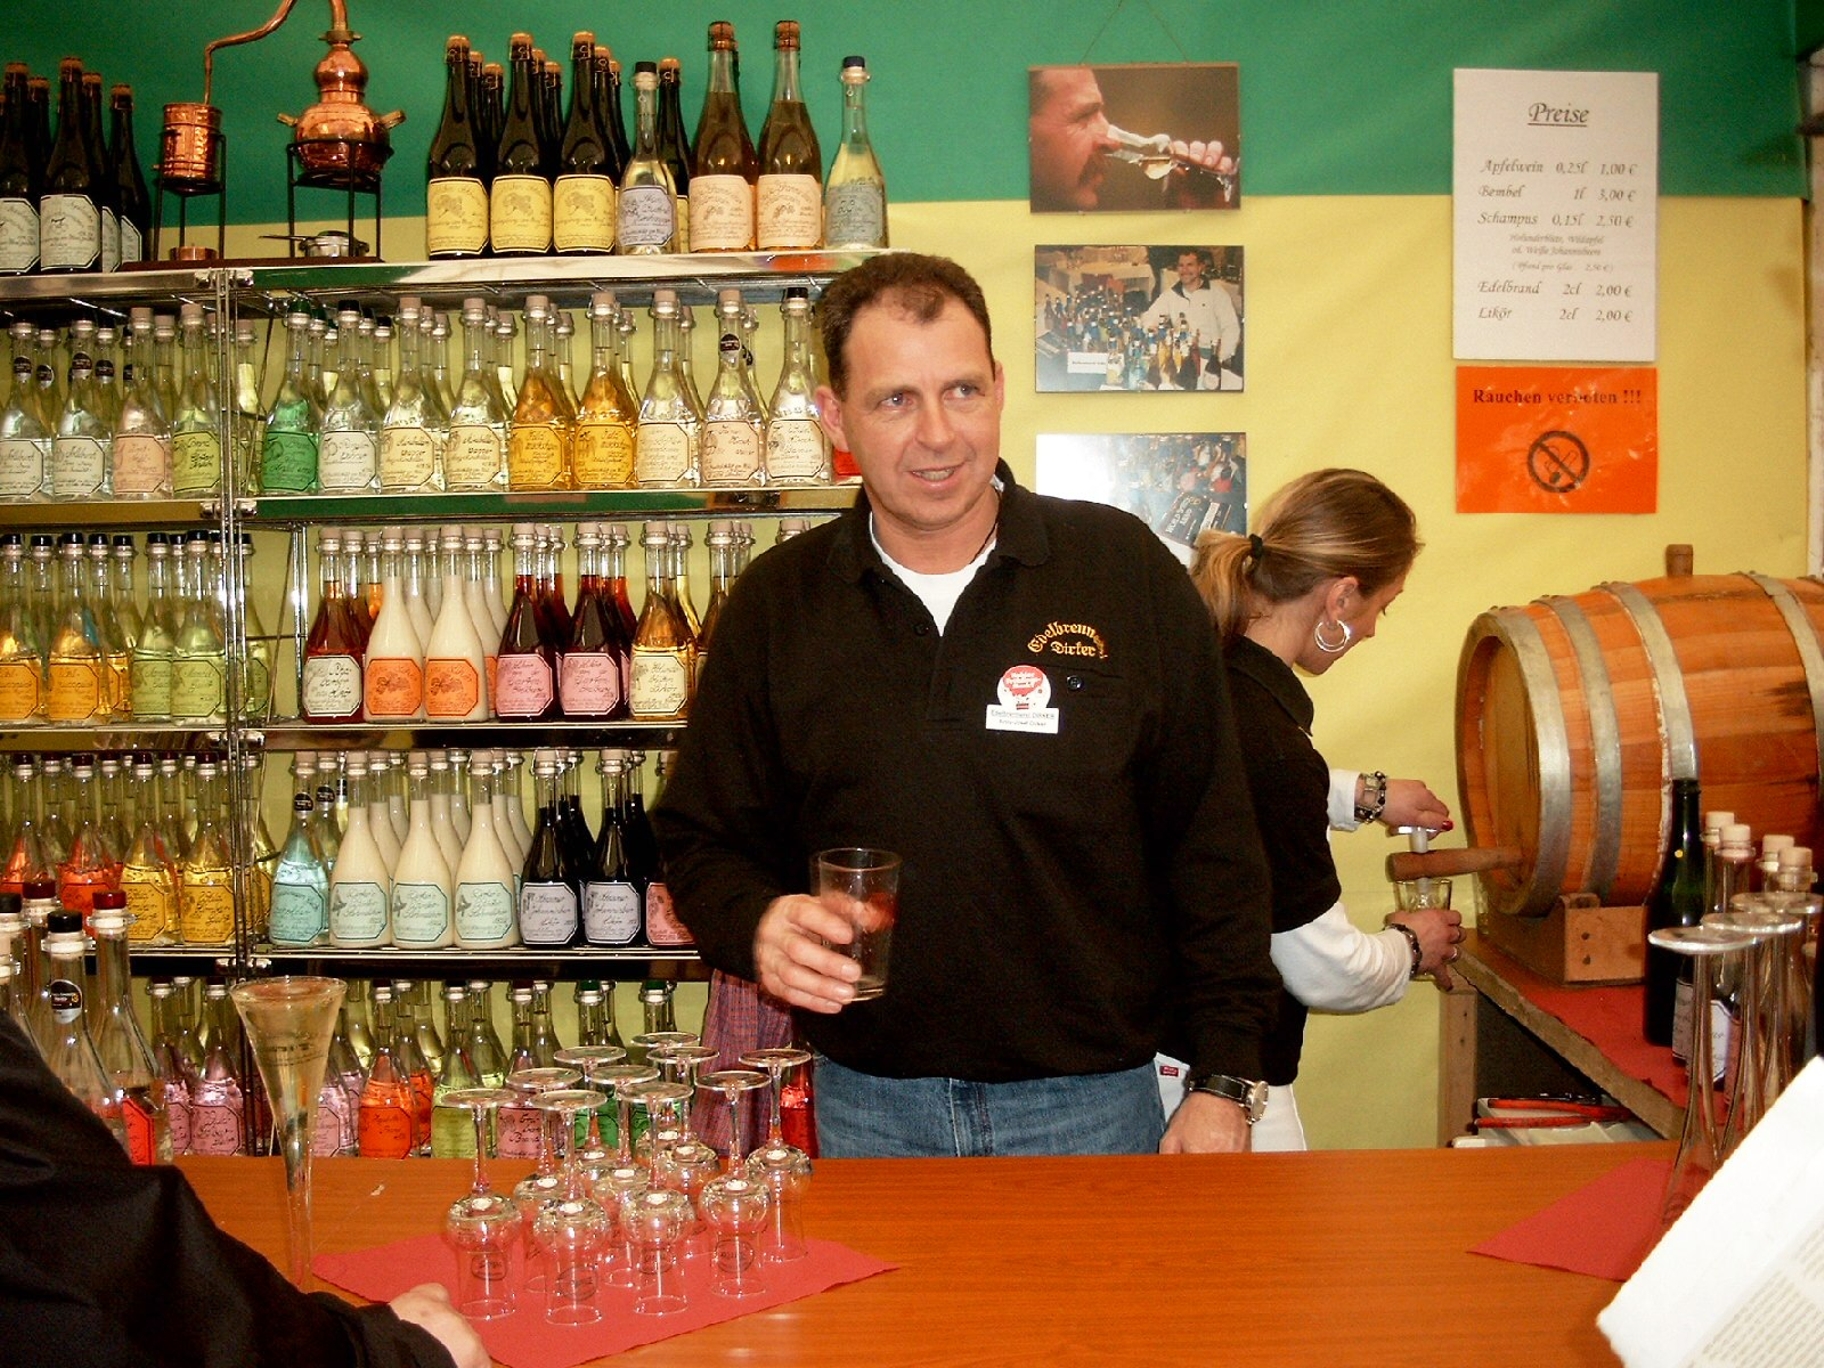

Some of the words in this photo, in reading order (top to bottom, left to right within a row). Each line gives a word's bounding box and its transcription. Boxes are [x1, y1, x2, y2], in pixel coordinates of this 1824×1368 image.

[1529, 102, 1590, 124] Preise
[1480, 157, 1544, 176] Apfelwein
[1555, 161, 1588, 174] 0,25l
[1600, 163, 1626, 175] 1,00
[1629, 163, 1638, 175] €
[1478, 184, 1525, 198] Bembel
[1599, 189, 1624, 201] 3,00
[1627, 190, 1637, 202] €
[1477, 211, 1539, 228] Schampus
[1625, 215, 1634, 228] €
[1478, 279, 1542, 294] Edelbrand
[1562, 282, 1583, 295] 2cl
[1595, 283, 1622, 296] 2,00
[1624, 284, 1633, 296] €
[1478, 305, 1513, 321] Likör
[1559, 307, 1580, 320] 2cl
[1595, 309, 1622, 322] 2,00
[1624, 310, 1633, 322] €
[1473, 389, 1542, 403] Rauchen
[1623, 389, 1641, 403] !!!
[1050, 641, 1096, 657] Dirker
